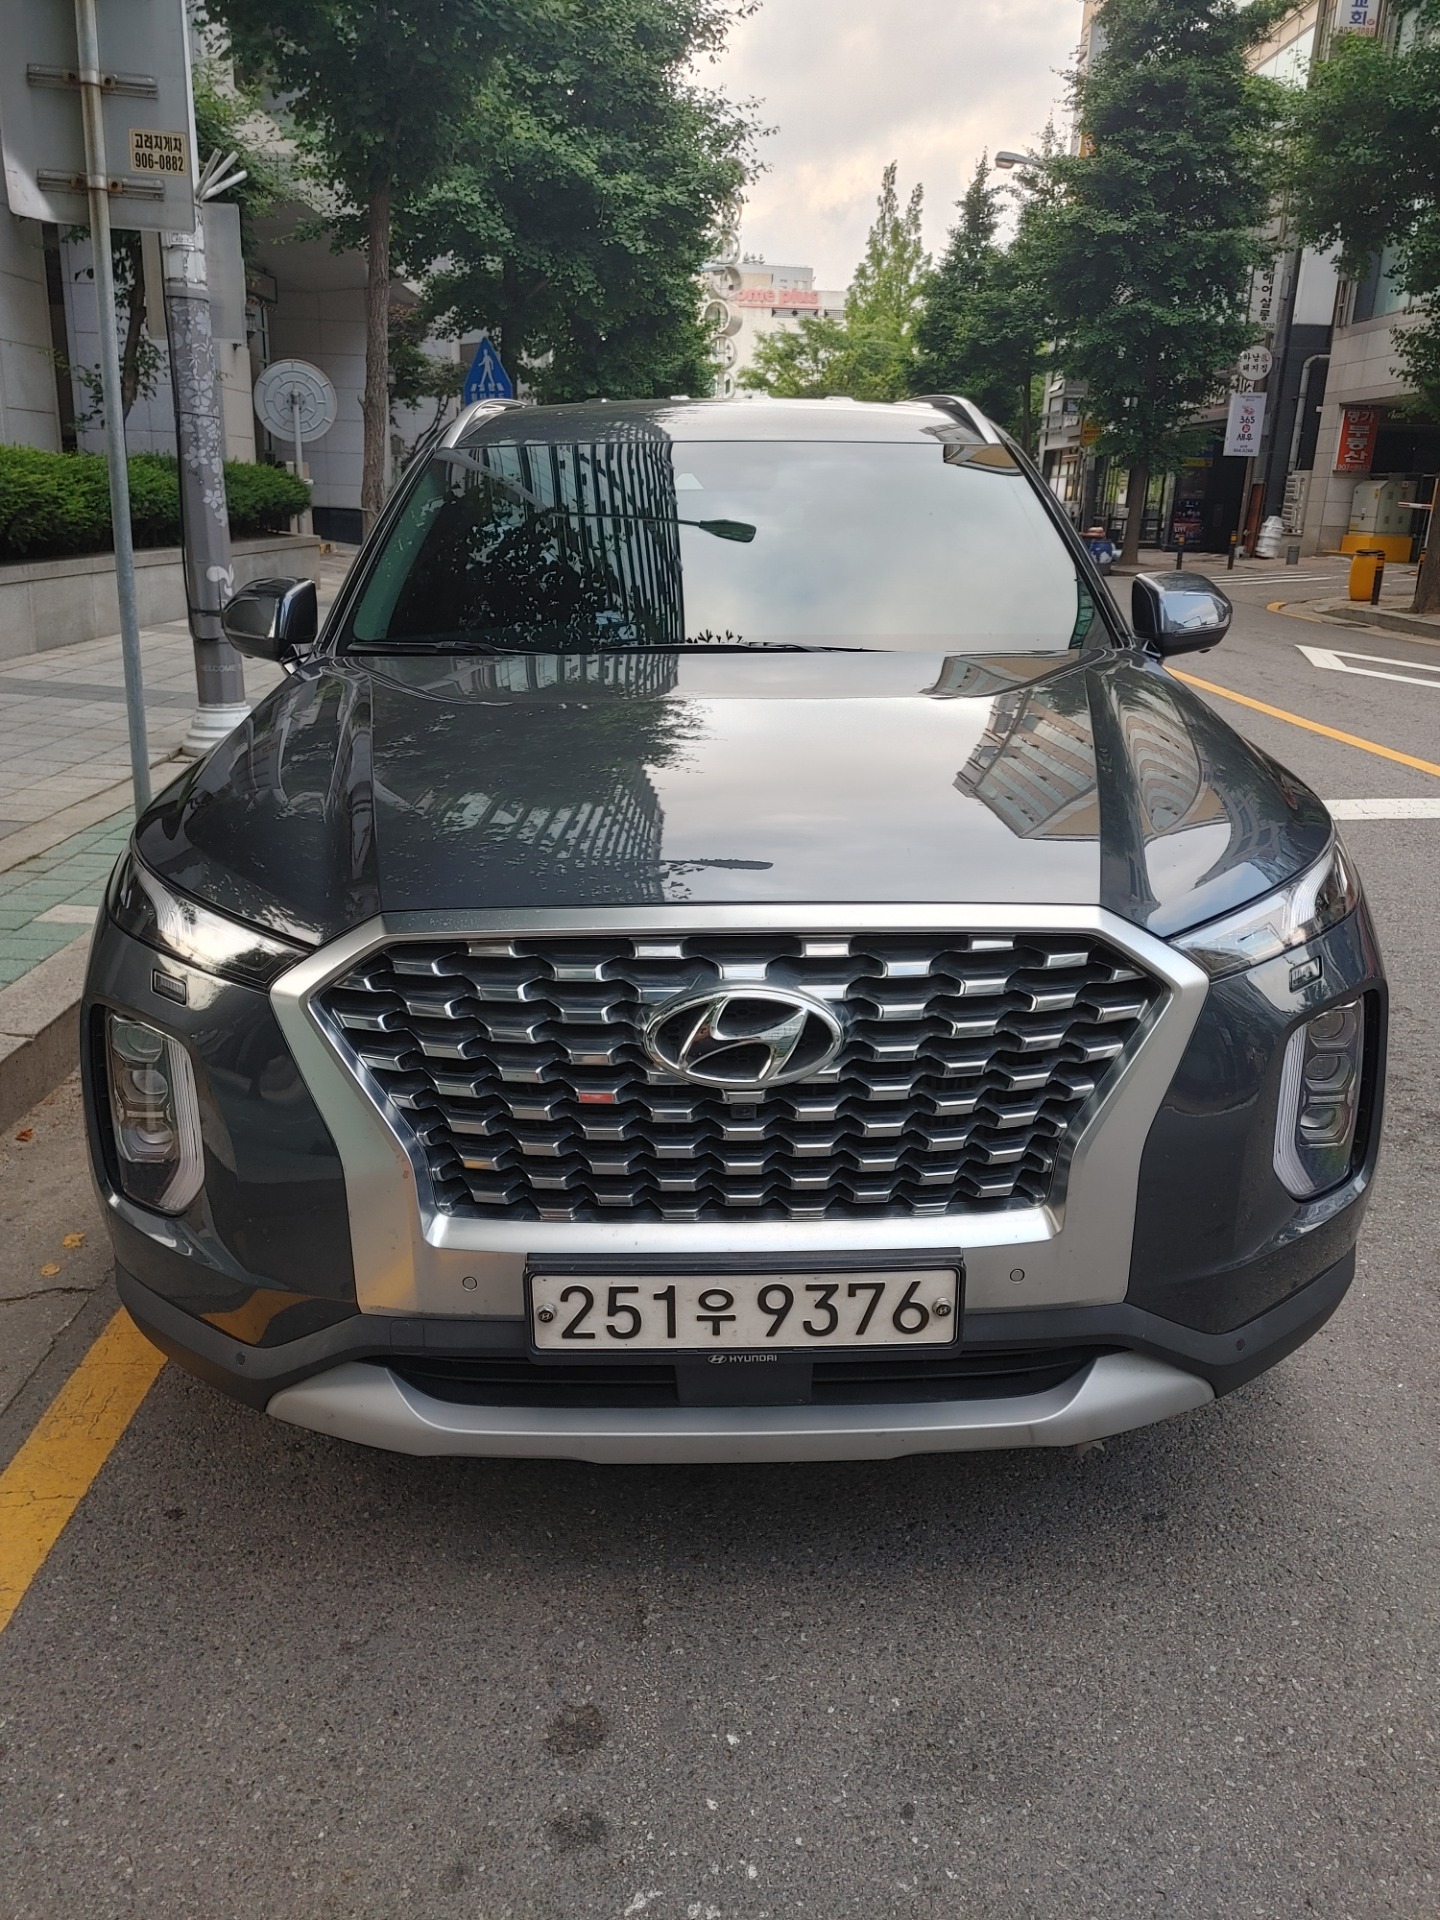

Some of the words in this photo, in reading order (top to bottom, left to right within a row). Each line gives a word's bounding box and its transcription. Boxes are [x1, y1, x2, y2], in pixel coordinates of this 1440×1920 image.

[134, 133, 182, 153] 고려지게차
[135, 152, 184, 171] 906-0882
[1239, 415, 1256, 424] 365
[729, 1354, 778, 1363] HYUNDAI
